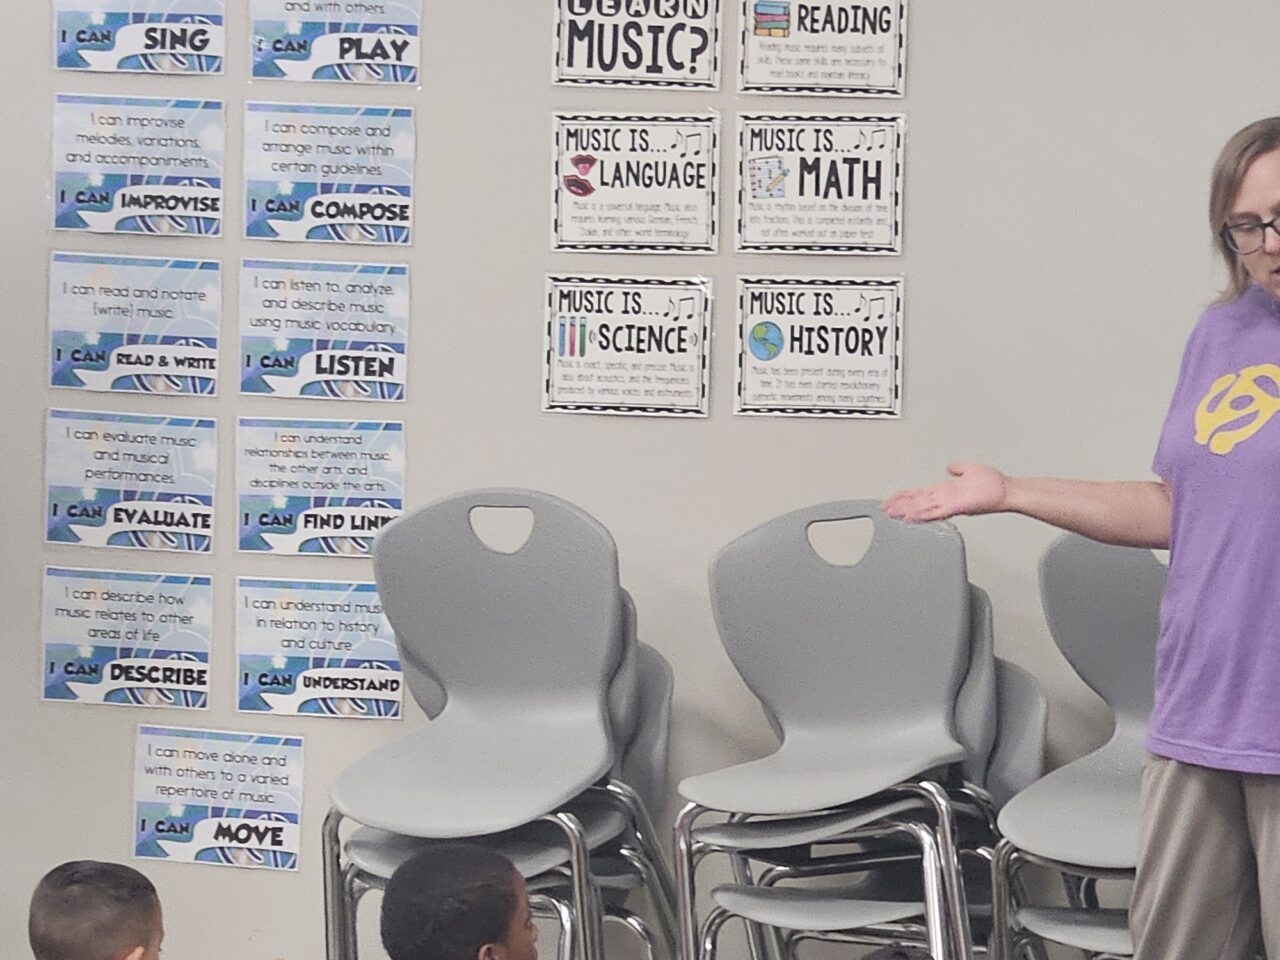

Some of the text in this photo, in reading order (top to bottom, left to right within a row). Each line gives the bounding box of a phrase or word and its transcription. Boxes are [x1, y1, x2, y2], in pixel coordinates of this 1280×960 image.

[284, 0, 310, 12] and
[315, 0, 341, 12] with
[797, 4, 892, 35] READING
[75, 30, 111, 43] CAN
[144, 27, 210, 51] SING
[273, 39, 308, 52] CAN
[339, 37, 410, 61] PLAY
[567, 19, 709, 74] MUSIC?
[566, 128, 667, 153] MUSIC IS...
[750, 128, 851, 153] MUSIC IS...
[600, 160, 706, 189] LANGUAGE
[799, 157, 882, 200] MATH
[75, 191, 109, 204] CAN
[121, 193, 220, 212] IMPROVISE
[265, 199, 299, 213] CAN
[311, 200, 409, 221] COMPOSE
[558, 290, 660, 315] MUSIC IS...
[750, 291, 851, 316] MUSIC IS...
[598, 323, 688, 354] SCIENCE
[789, 325, 888, 356] HISTORY
[71, 349, 105, 362] CAN
[116, 353, 154, 367] READ
[158, 355, 169, 367] &
[174, 356, 216, 370] WRITE
[260, 355, 295, 368] CAN
[315, 354, 394, 377] LISTEN
[67, 504, 104, 518] CAN
[113, 507, 211, 529] EVALUATE
[258, 513, 294, 526] CAN
[304, 513, 345, 529] FIND
[64, 662, 99, 676] CAN
[110, 663, 208, 685] DESCRIBE
[258, 673, 293, 686] CAN
[303, 676, 400, 692] UNDERSTAND
[155, 820, 189, 834] CAN
[213, 822, 284, 846] MOVE
